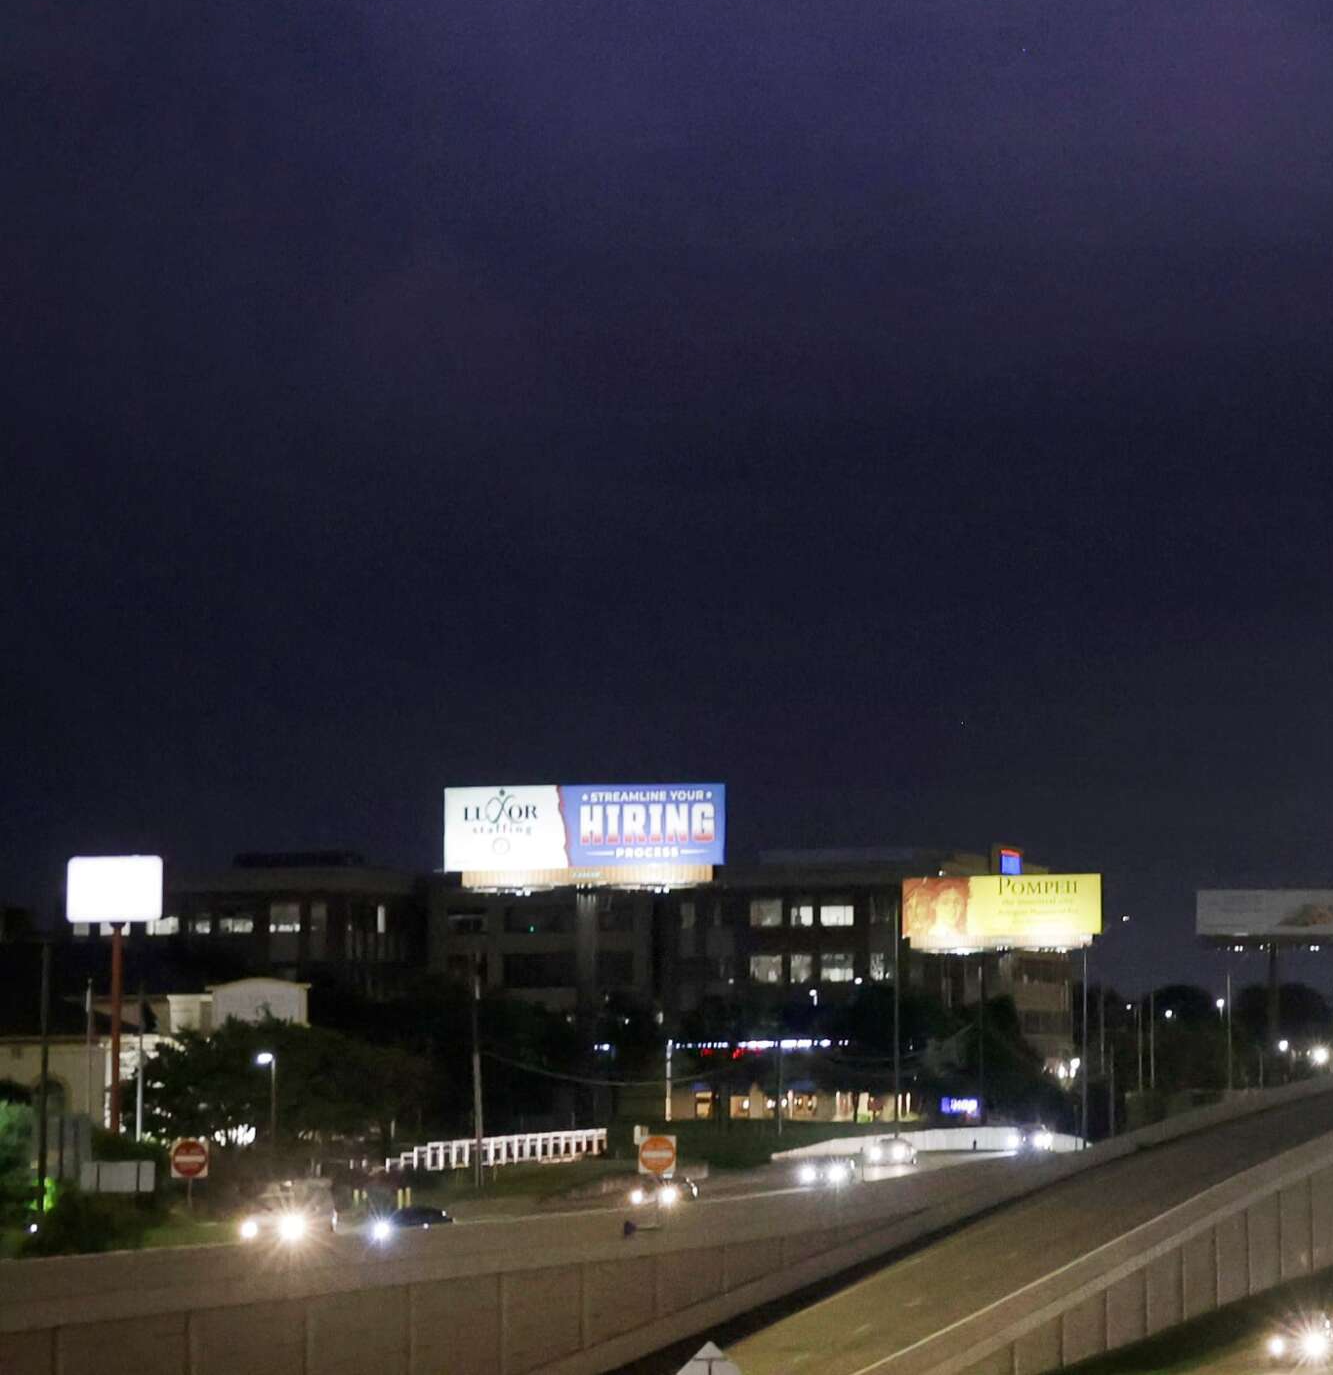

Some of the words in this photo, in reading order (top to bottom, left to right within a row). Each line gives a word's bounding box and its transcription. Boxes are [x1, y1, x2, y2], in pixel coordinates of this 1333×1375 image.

[590, 790, 666, 802] STREAMLINE
[670, 790, 705, 801] YOUR
[579, 802, 716, 846] HIRING
[614, 846, 680, 859] PROCESS
